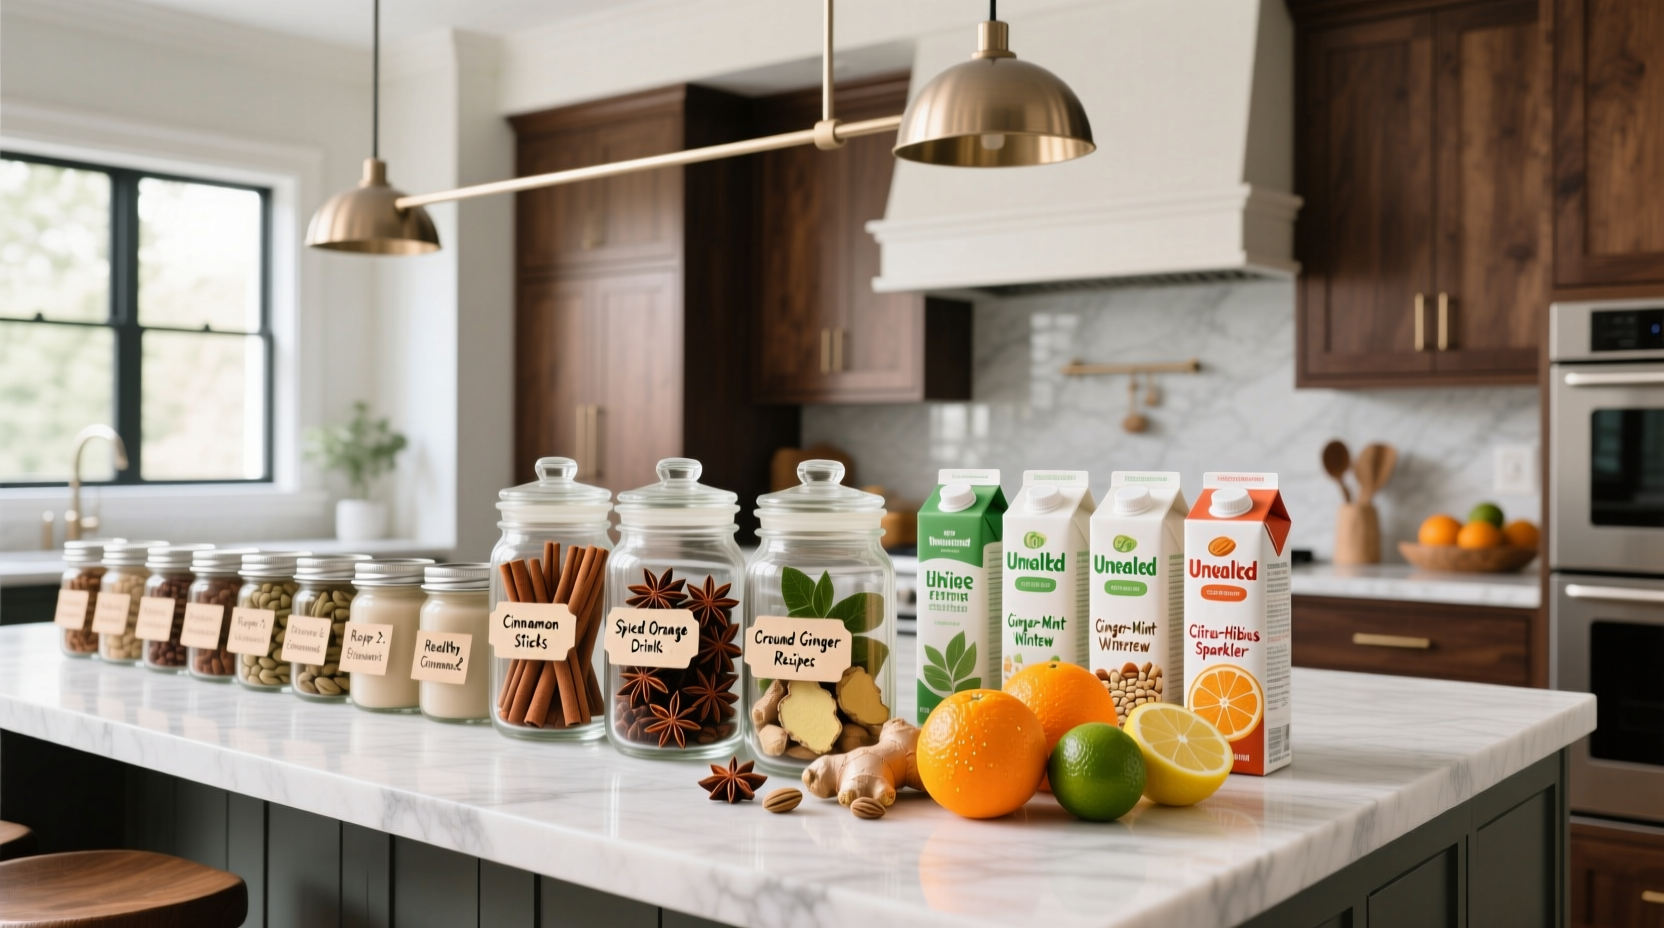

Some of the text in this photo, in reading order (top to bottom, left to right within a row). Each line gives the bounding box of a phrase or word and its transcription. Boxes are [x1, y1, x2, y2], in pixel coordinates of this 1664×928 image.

[502, 614, 559, 630] Cinnamon
[800, 630, 842, 653] Ginger
[1196, 641, 1250, 660] Sparkler
